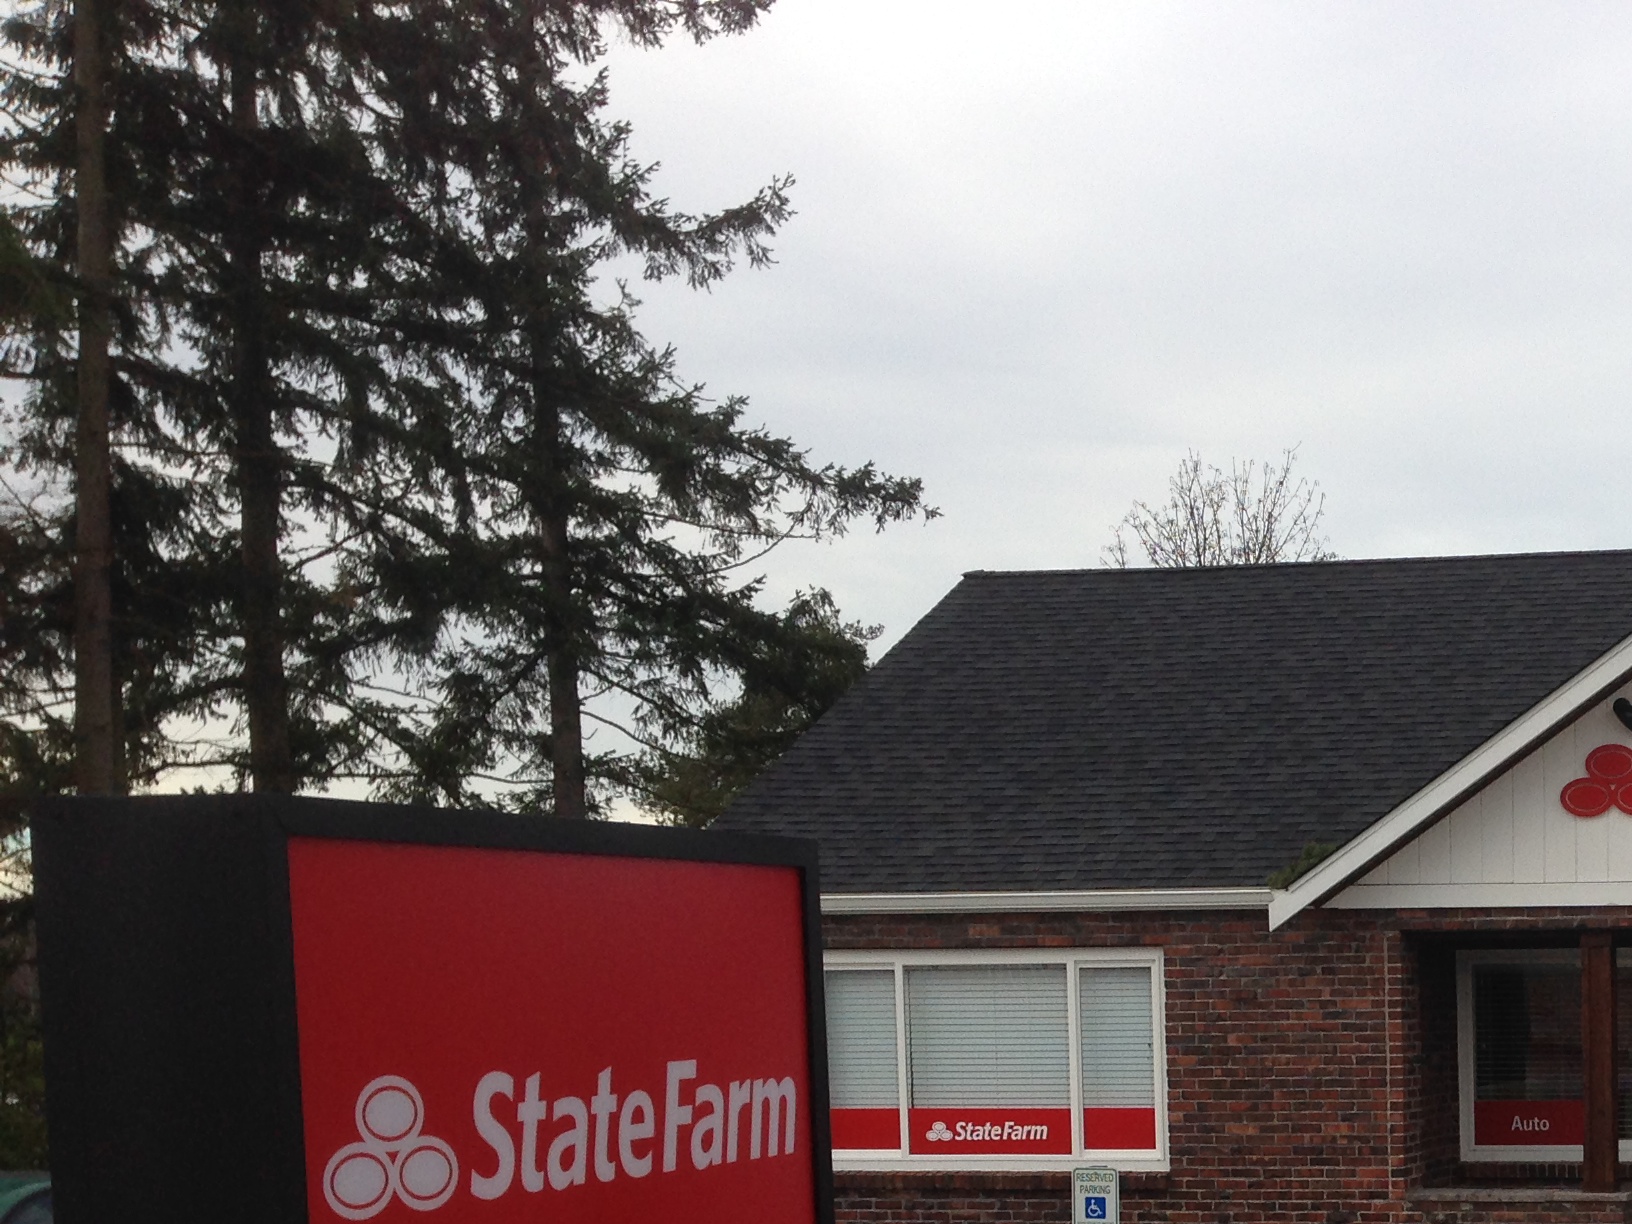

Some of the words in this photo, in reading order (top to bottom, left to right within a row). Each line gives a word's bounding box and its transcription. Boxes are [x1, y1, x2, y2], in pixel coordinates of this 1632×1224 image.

[1511, 1115, 1550, 1131] Auto
[1076, 1172, 1114, 1182] RESERVED
[1079, 1184, 1111, 1194] PARKING
